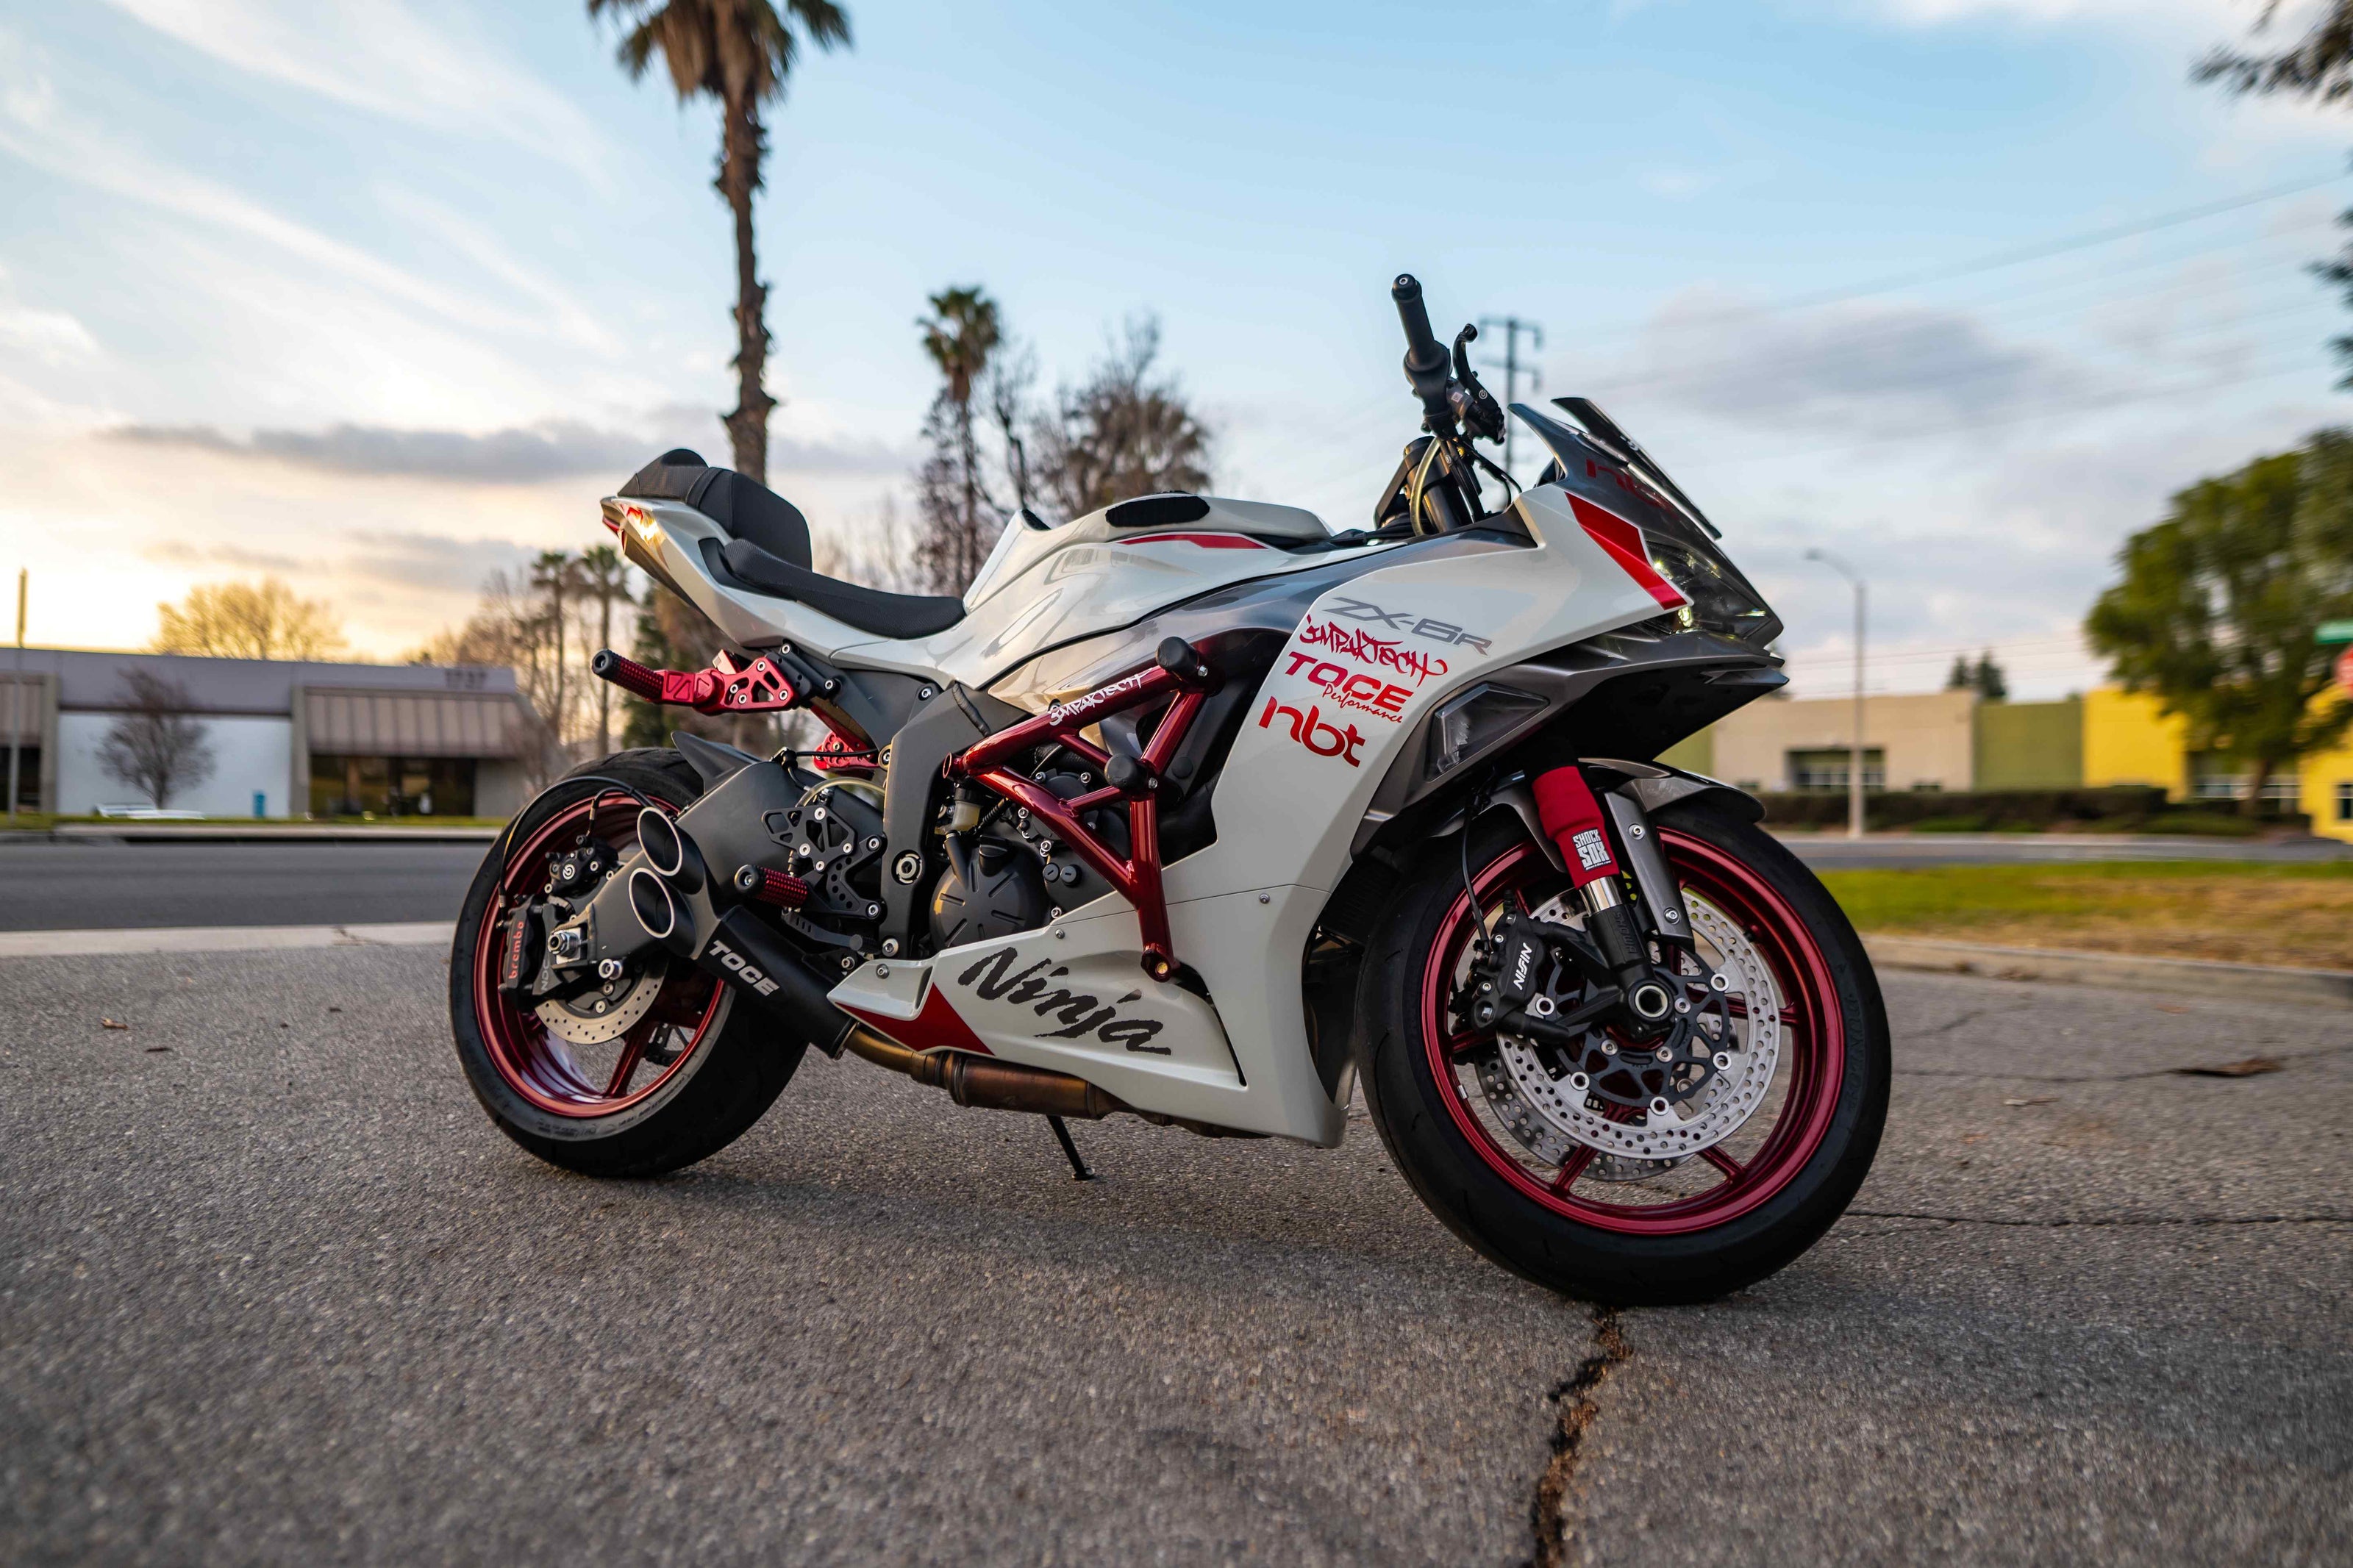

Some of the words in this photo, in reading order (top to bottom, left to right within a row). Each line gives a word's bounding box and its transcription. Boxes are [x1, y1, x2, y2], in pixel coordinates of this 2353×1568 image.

[1322, 597, 1493, 656] ZX-6R
[1285, 651, 1415, 712] TOCE
[1322, 683, 1402, 723] Performance
[1258, 695, 1366, 768] nbt
[1573, 828, 1601, 849] SHOCK
[1577, 841, 1610, 869] SOX
[509, 920, 524, 979] brembo
[709, 939, 780, 996] TOCE
[957, 947, 1171, 1056] Ninja
